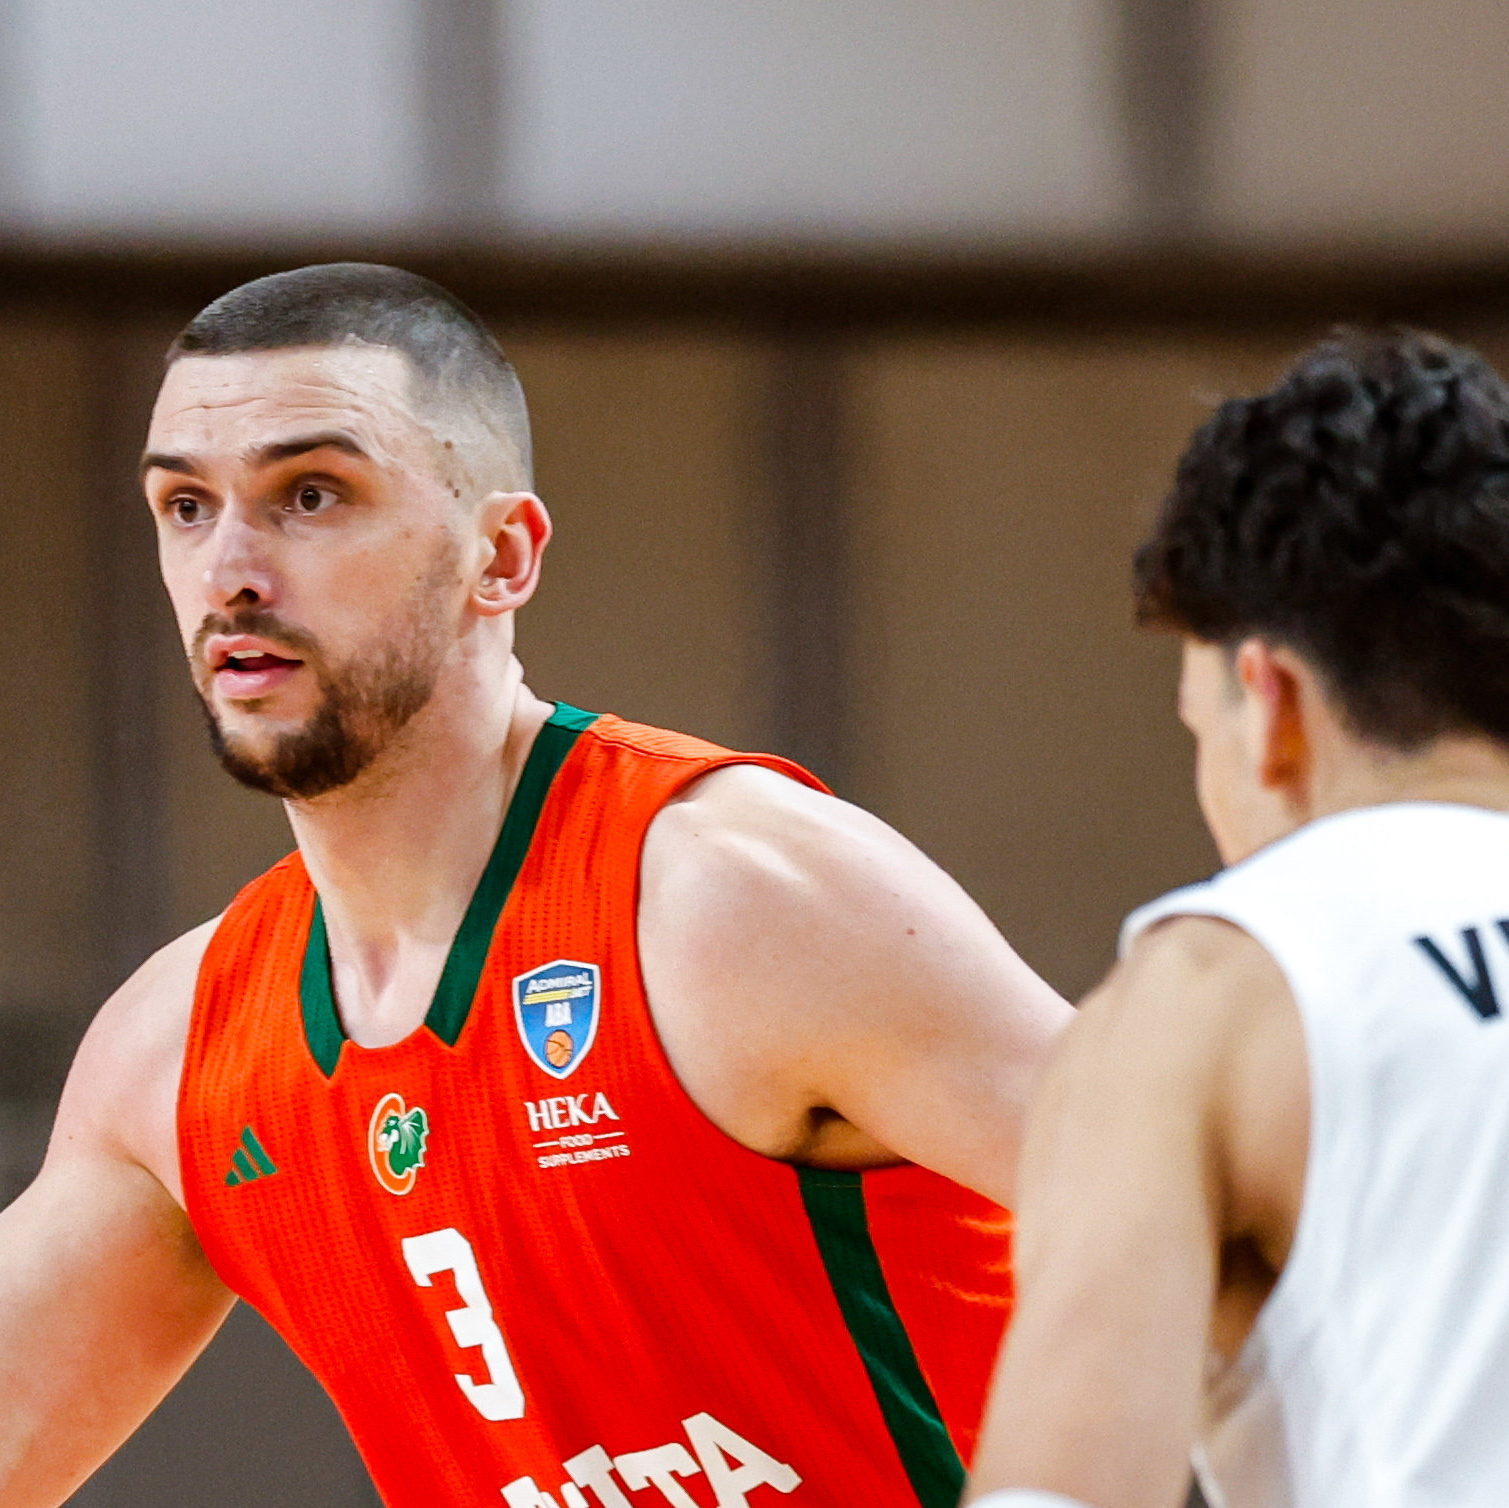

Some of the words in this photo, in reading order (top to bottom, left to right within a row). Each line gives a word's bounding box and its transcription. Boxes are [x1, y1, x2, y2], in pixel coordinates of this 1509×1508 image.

[526, 971, 593, 994] ADMIRAL
[523, 1091, 621, 1132] HEKA
[558, 1133, 594, 1148] FOOD
[537, 1144, 631, 1169] SUPPLEMENTS
[401, 1228, 525, 1421] 3
